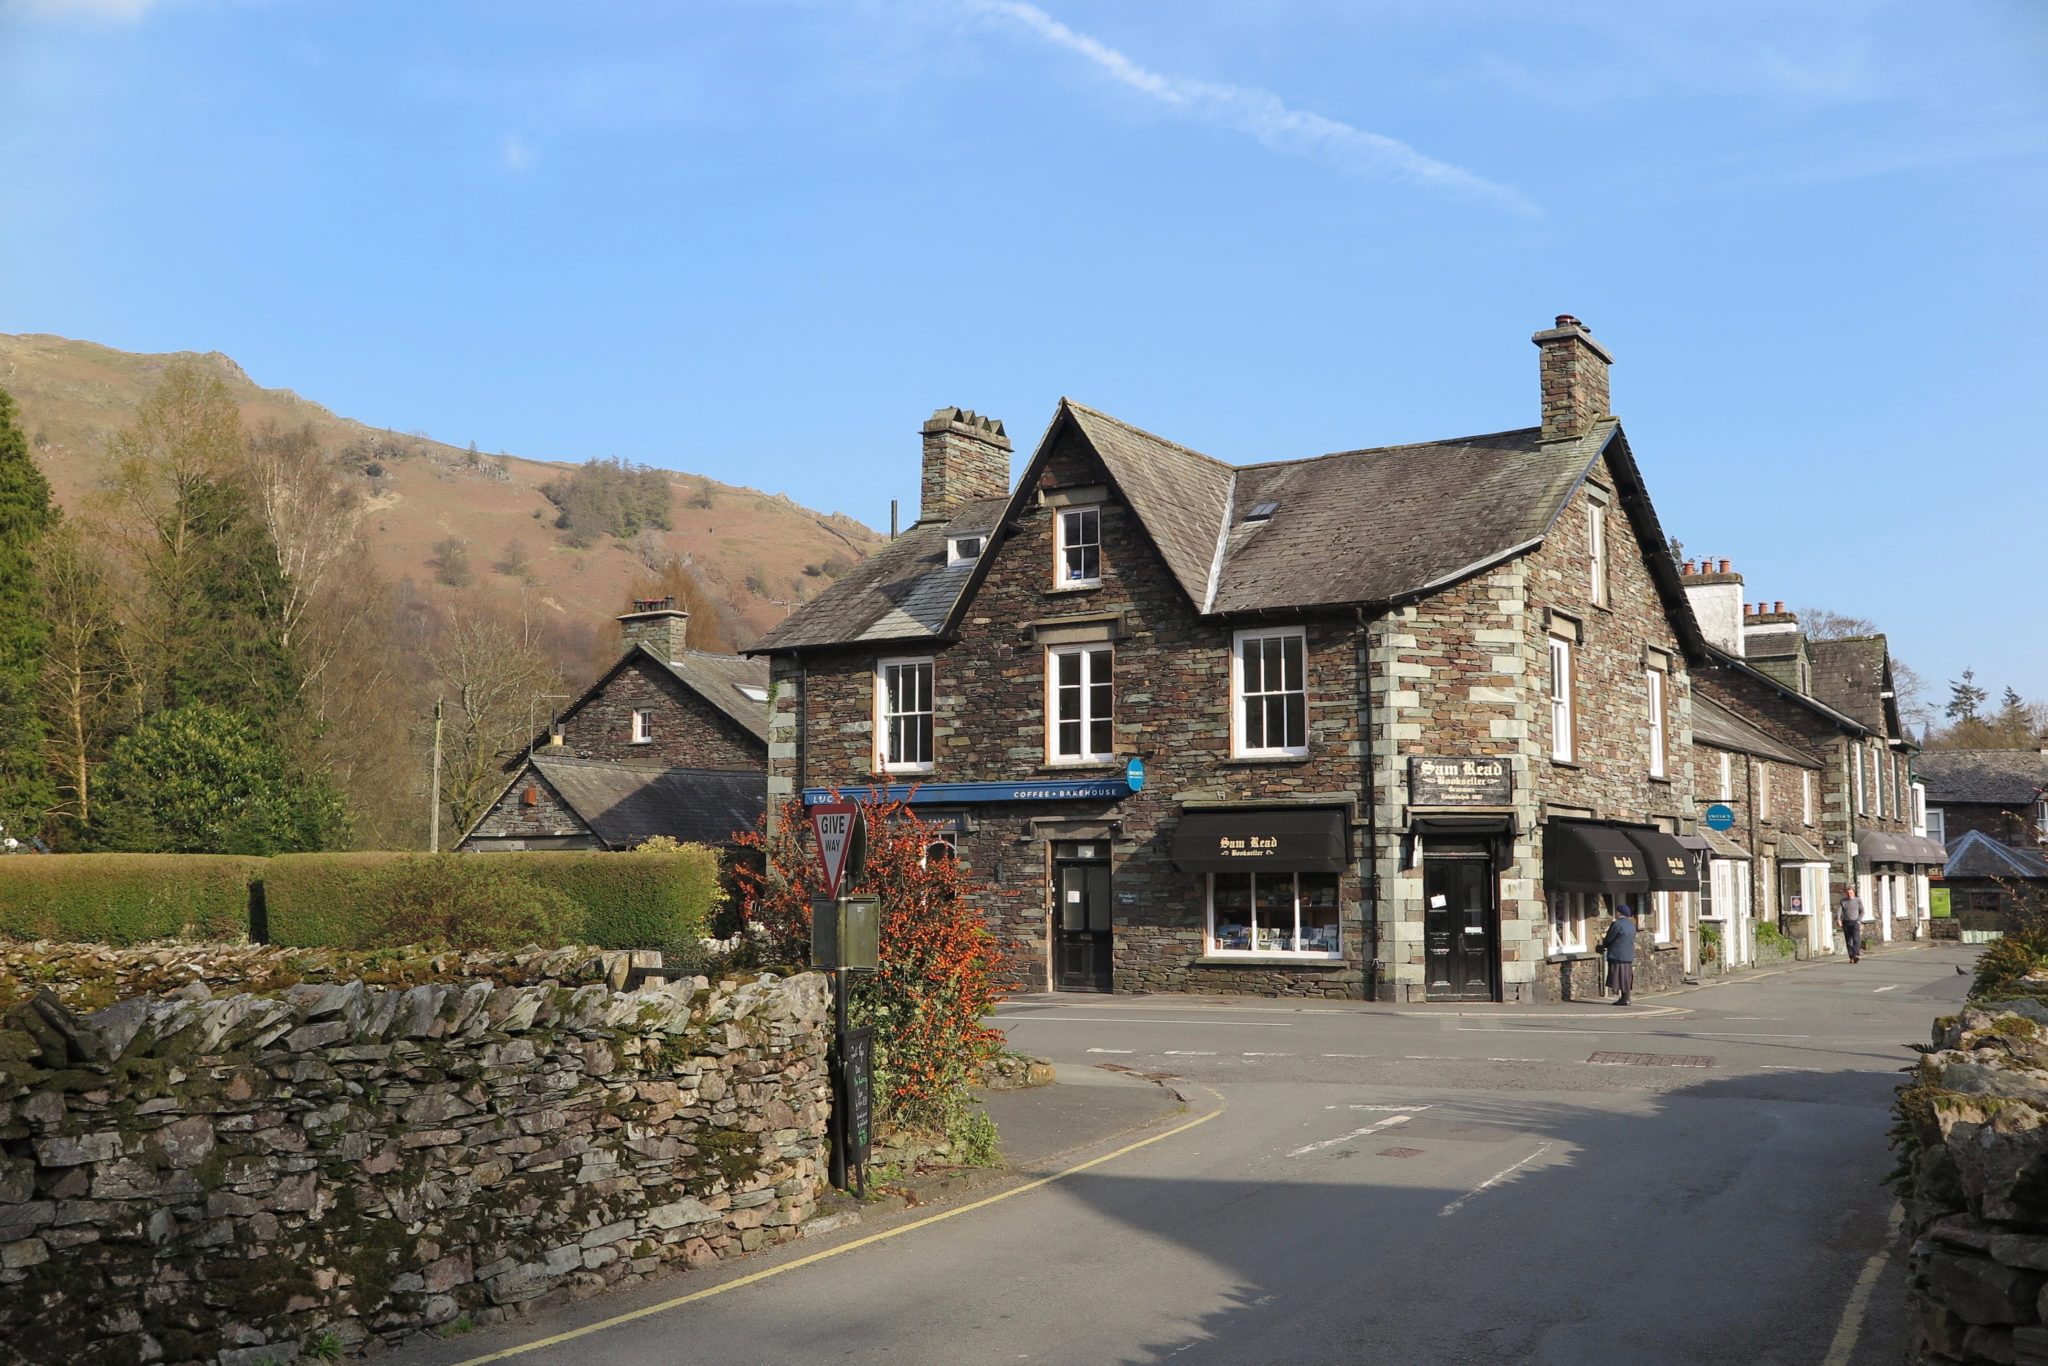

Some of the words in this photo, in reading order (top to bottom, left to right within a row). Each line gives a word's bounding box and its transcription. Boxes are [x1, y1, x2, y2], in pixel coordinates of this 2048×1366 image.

[1420, 760, 1459, 776] Sam
[1462, 760, 1503, 776] Read
[1436, 776, 1487, 786] Bookseller
[1013, 791, 1050, 799] COFFEE
[1059, 788, 1117, 798] BAKEHOUSE
[821, 815, 845, 835] GIVE
[825, 839, 840, 852] WAY
[1220, 836, 1245, 849] Sam
[1250, 836, 1278, 849] Read
